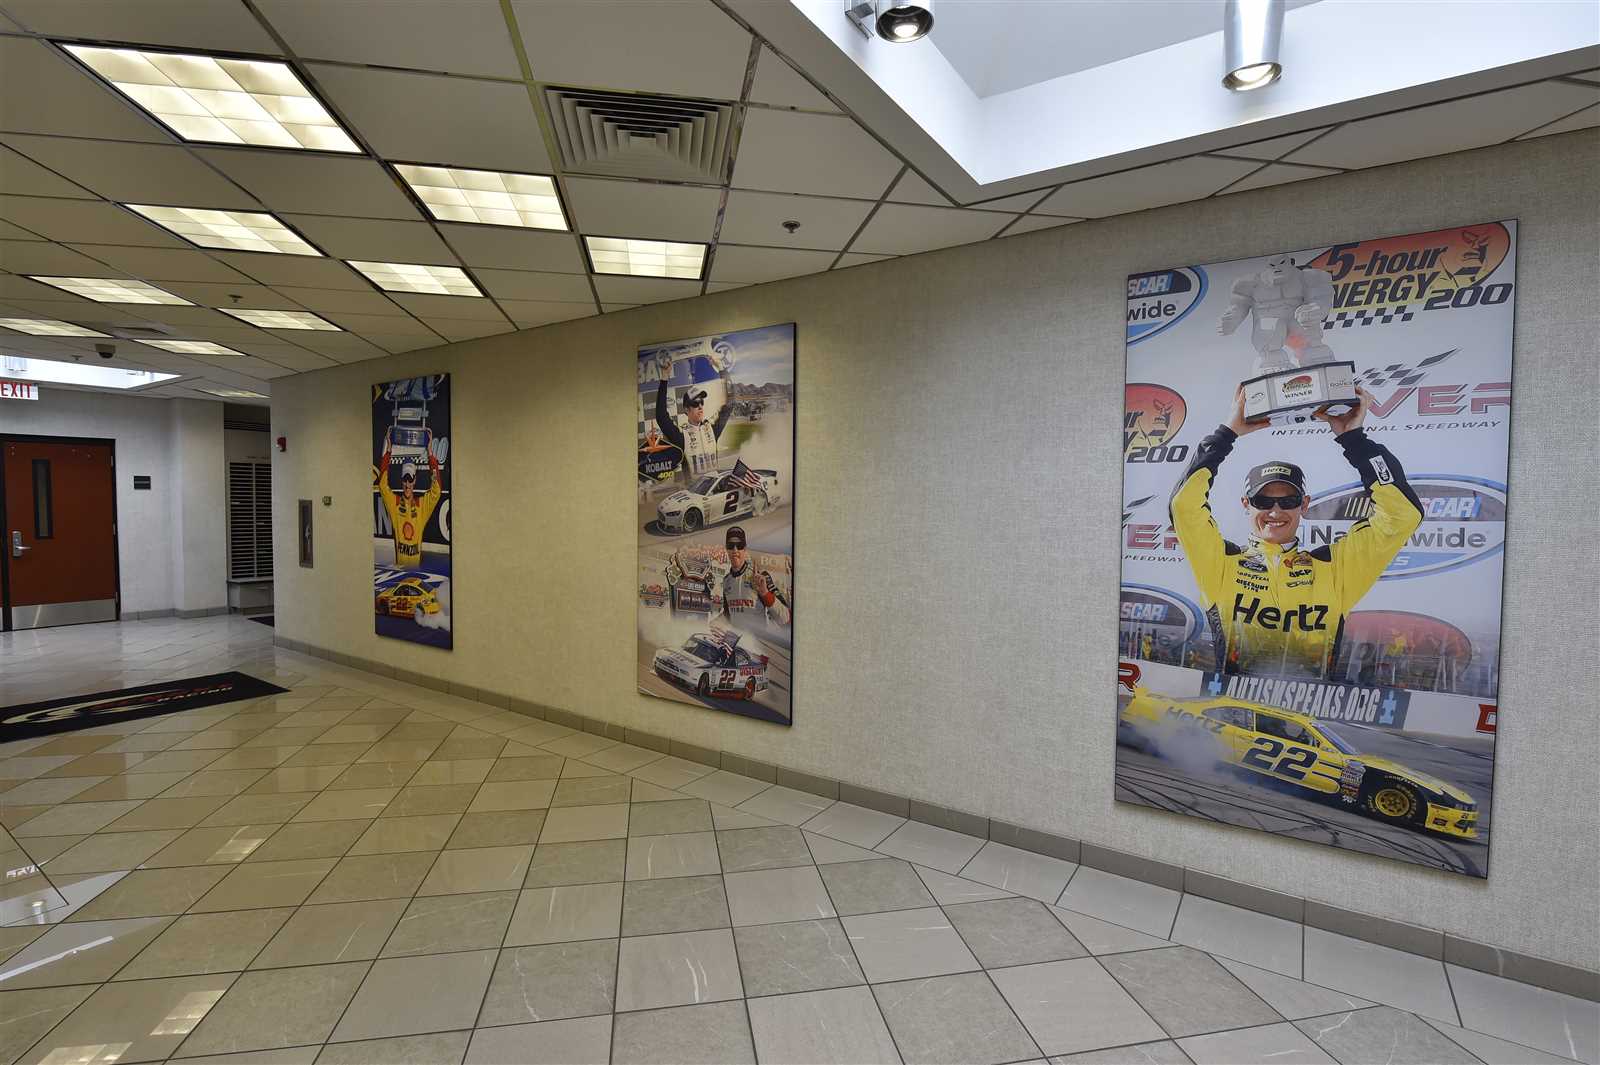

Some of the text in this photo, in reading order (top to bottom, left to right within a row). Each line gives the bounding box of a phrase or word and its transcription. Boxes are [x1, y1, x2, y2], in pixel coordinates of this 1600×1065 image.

[1326, 243, 1448, 281] 5-hour
[1333, 271, 1514, 311] NERGY 200
[1127, 300, 1177, 321] wide
[1, 382, 32, 398] EXIT
[1271, 420, 1501, 436] INTERNNAL SPEEDWAY
[1126, 445, 1189, 463] 200
[645, 461, 673, 473] KOBALT
[658, 471, 673, 479] 400
[723, 491, 739, 515] 2
[1121, 554, 1185, 563] PEEDWAY
[1233, 593, 1329, 633] Hertz
[719, 669, 737, 689] 22
[1226, 675, 1380, 723] AUTISMSPEAKS.ORG
[1166, 706, 1227, 735] Hertz
[1241, 737, 1319, 781] 22
